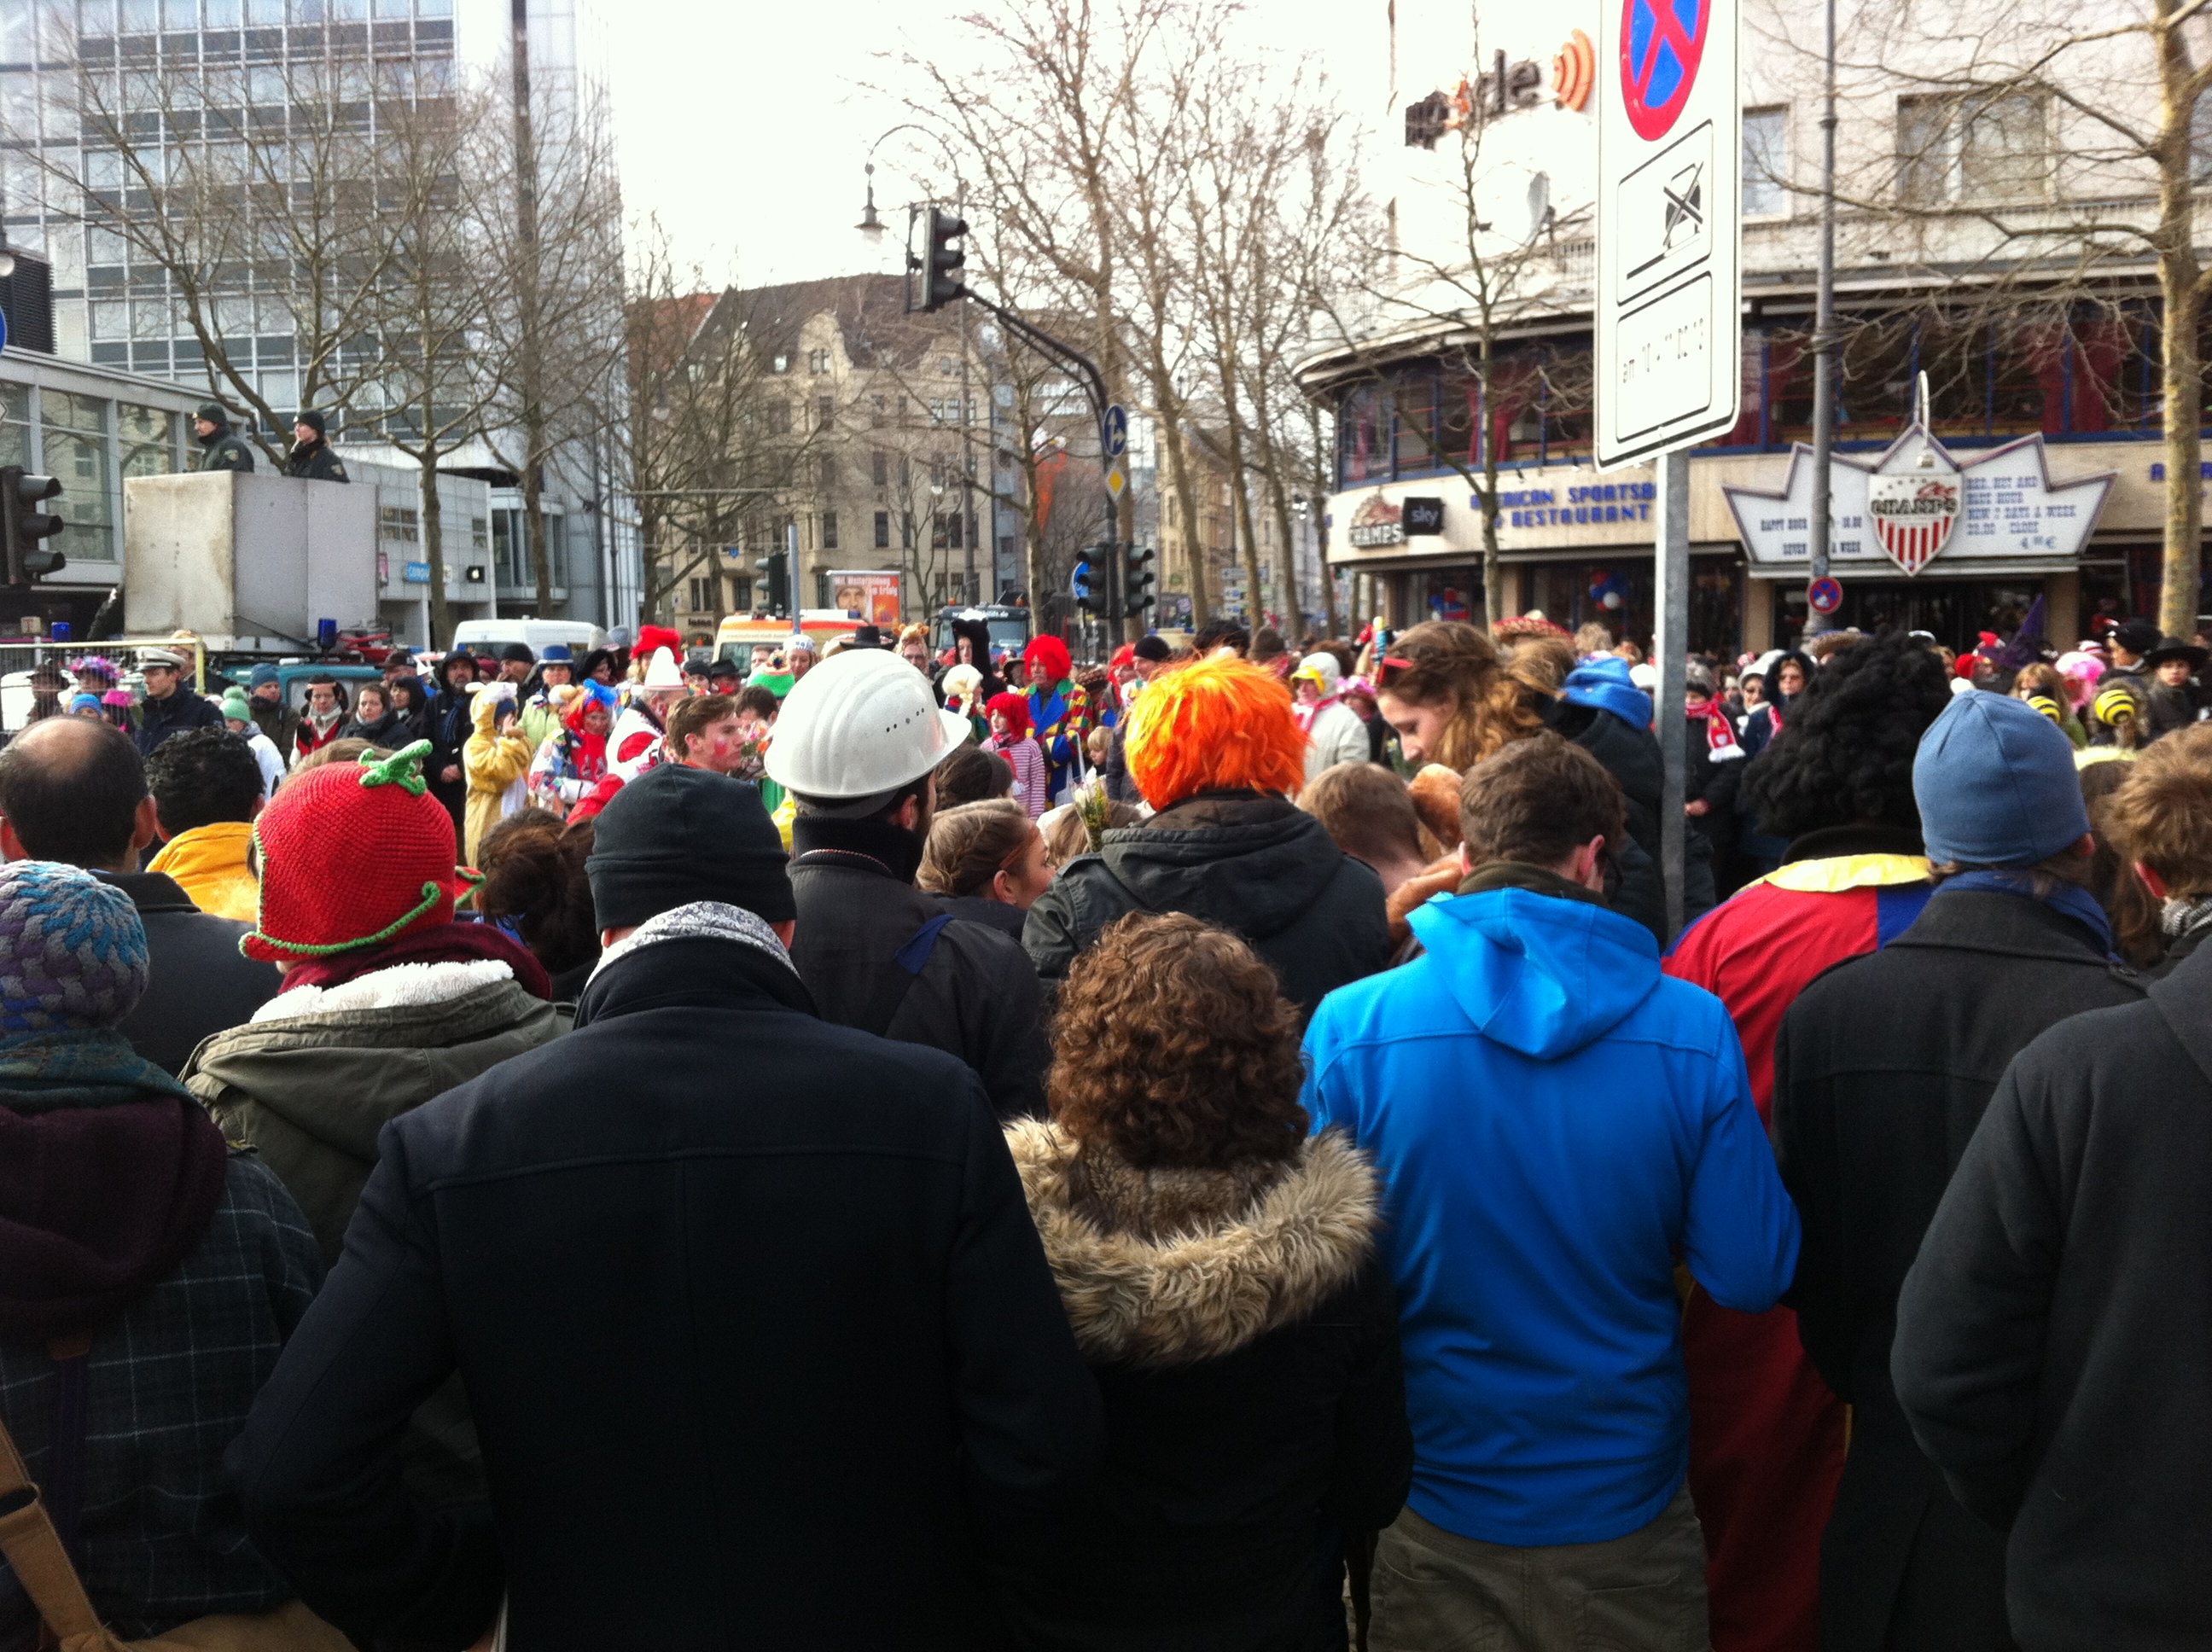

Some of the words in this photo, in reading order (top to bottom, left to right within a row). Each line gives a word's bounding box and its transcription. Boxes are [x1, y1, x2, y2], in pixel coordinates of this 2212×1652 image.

[1411, 505, 1440, 527] sky
[1511, 503, 1650, 527] RESTAURANT
[1348, 523, 1401, 547] CHAMPS
